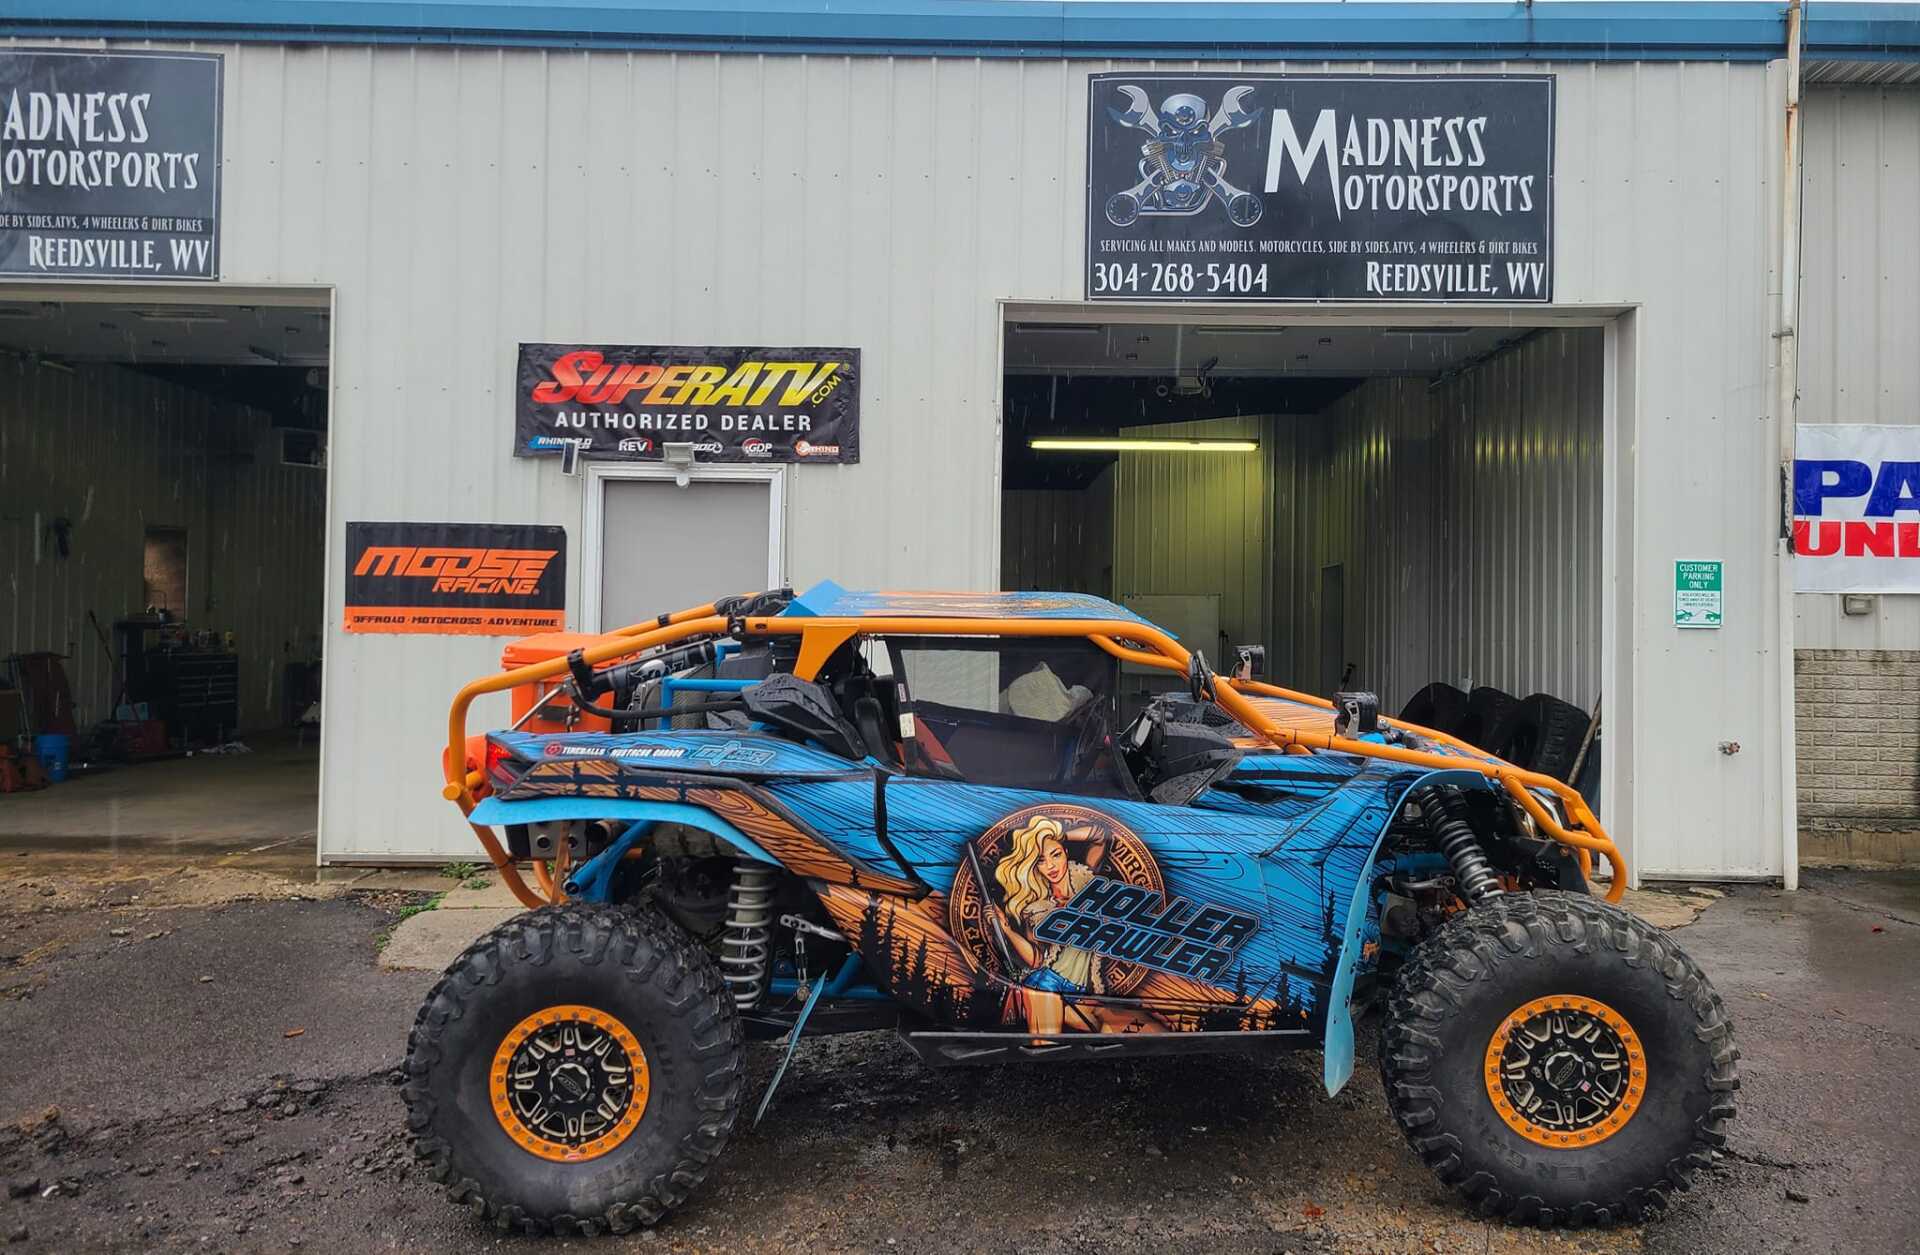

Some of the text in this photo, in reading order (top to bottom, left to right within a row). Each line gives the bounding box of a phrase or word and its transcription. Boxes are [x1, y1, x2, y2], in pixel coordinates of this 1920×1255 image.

[0, 87, 151, 149] ADNESS
[1264, 109, 1488, 222] MADNESS
[13, 215, 28, 227] BY
[83, 216, 89, 228] 4
[92, 216, 140, 230] WHEELERS
[142, 217, 149, 230] &
[152, 218, 173, 231] DIRT
[176, 219, 203, 232] BIKES
[28, 235, 210, 272] REEDSVILLE, WV
[1100, 240, 1147, 252] SERVICING
[1150, 240, 1163, 252] ALL
[1167, 240, 1196, 252] MAKES
[1199, 240, 1216, 252] AND
[1259, 240, 1326, 254] MOTORCYCLES,
[1328, 240, 1348, 253] SIDE
[1350, 241, 1362, 253] BY
[1420, 241, 1426, 253] 4
[1429, 241, 1477, 254] WHEELERS
[1478, 241, 1486, 254] &
[1489, 242, 1510, 254] DIRT
[1512, 242, 1538, 255] BIKES
[1094, 262, 1269, 293] 304-268-5404
[1366, 261, 1545, 296] REEDSVILLE, WV
[554, 411, 811, 431] AUTHORIZED DEALER
[748, 442, 773, 453] GDP
[354, 547, 560, 579] MOOSE
[1680, 563, 1718, 572] CUSTOMER
[1683, 572, 1715, 580] PARKING
[1689, 581, 1708, 589] ONLY
[432, 578, 538, 595] RACING
[353, 615, 558, 627] OFFROAD MOTOCROSS ADVENTURE
[1066, 876, 1261, 951] HOLLER
[1033, 907, 1234, 983] CRAWLER
